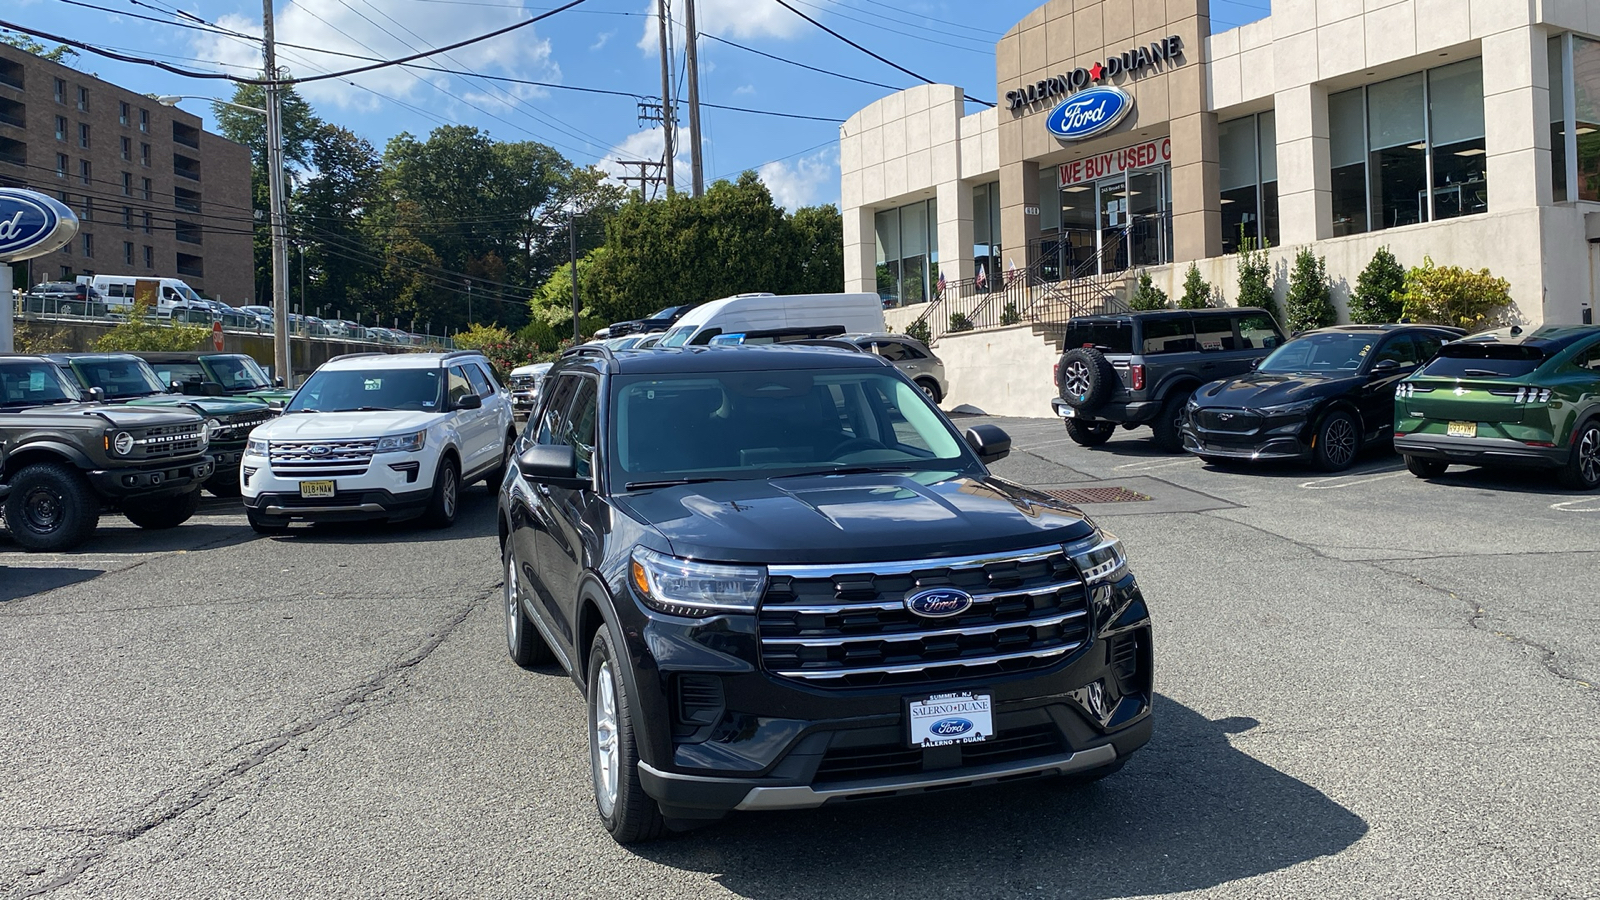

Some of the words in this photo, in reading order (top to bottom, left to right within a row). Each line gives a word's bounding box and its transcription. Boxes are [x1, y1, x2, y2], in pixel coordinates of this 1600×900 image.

[1005, 67, 1089, 110] SALERNO
[1106, 35, 1182, 77] DUANE
[1061, 97, 1107, 132] Ford
[1060, 162, 1081, 185] WE
[1085, 154, 1113, 179] BUY
[1117, 143, 1156, 170] USED
[213, 331, 223, 343] STOP
[148, 433, 197, 444] BRONCO
[924, 594, 958, 612] Ford
[912, 705, 952, 716] SALERNO
[958, 701, 988, 712] DUANE
[938, 720, 964, 734] Ford
[920, 740, 952, 748] SALERNO
